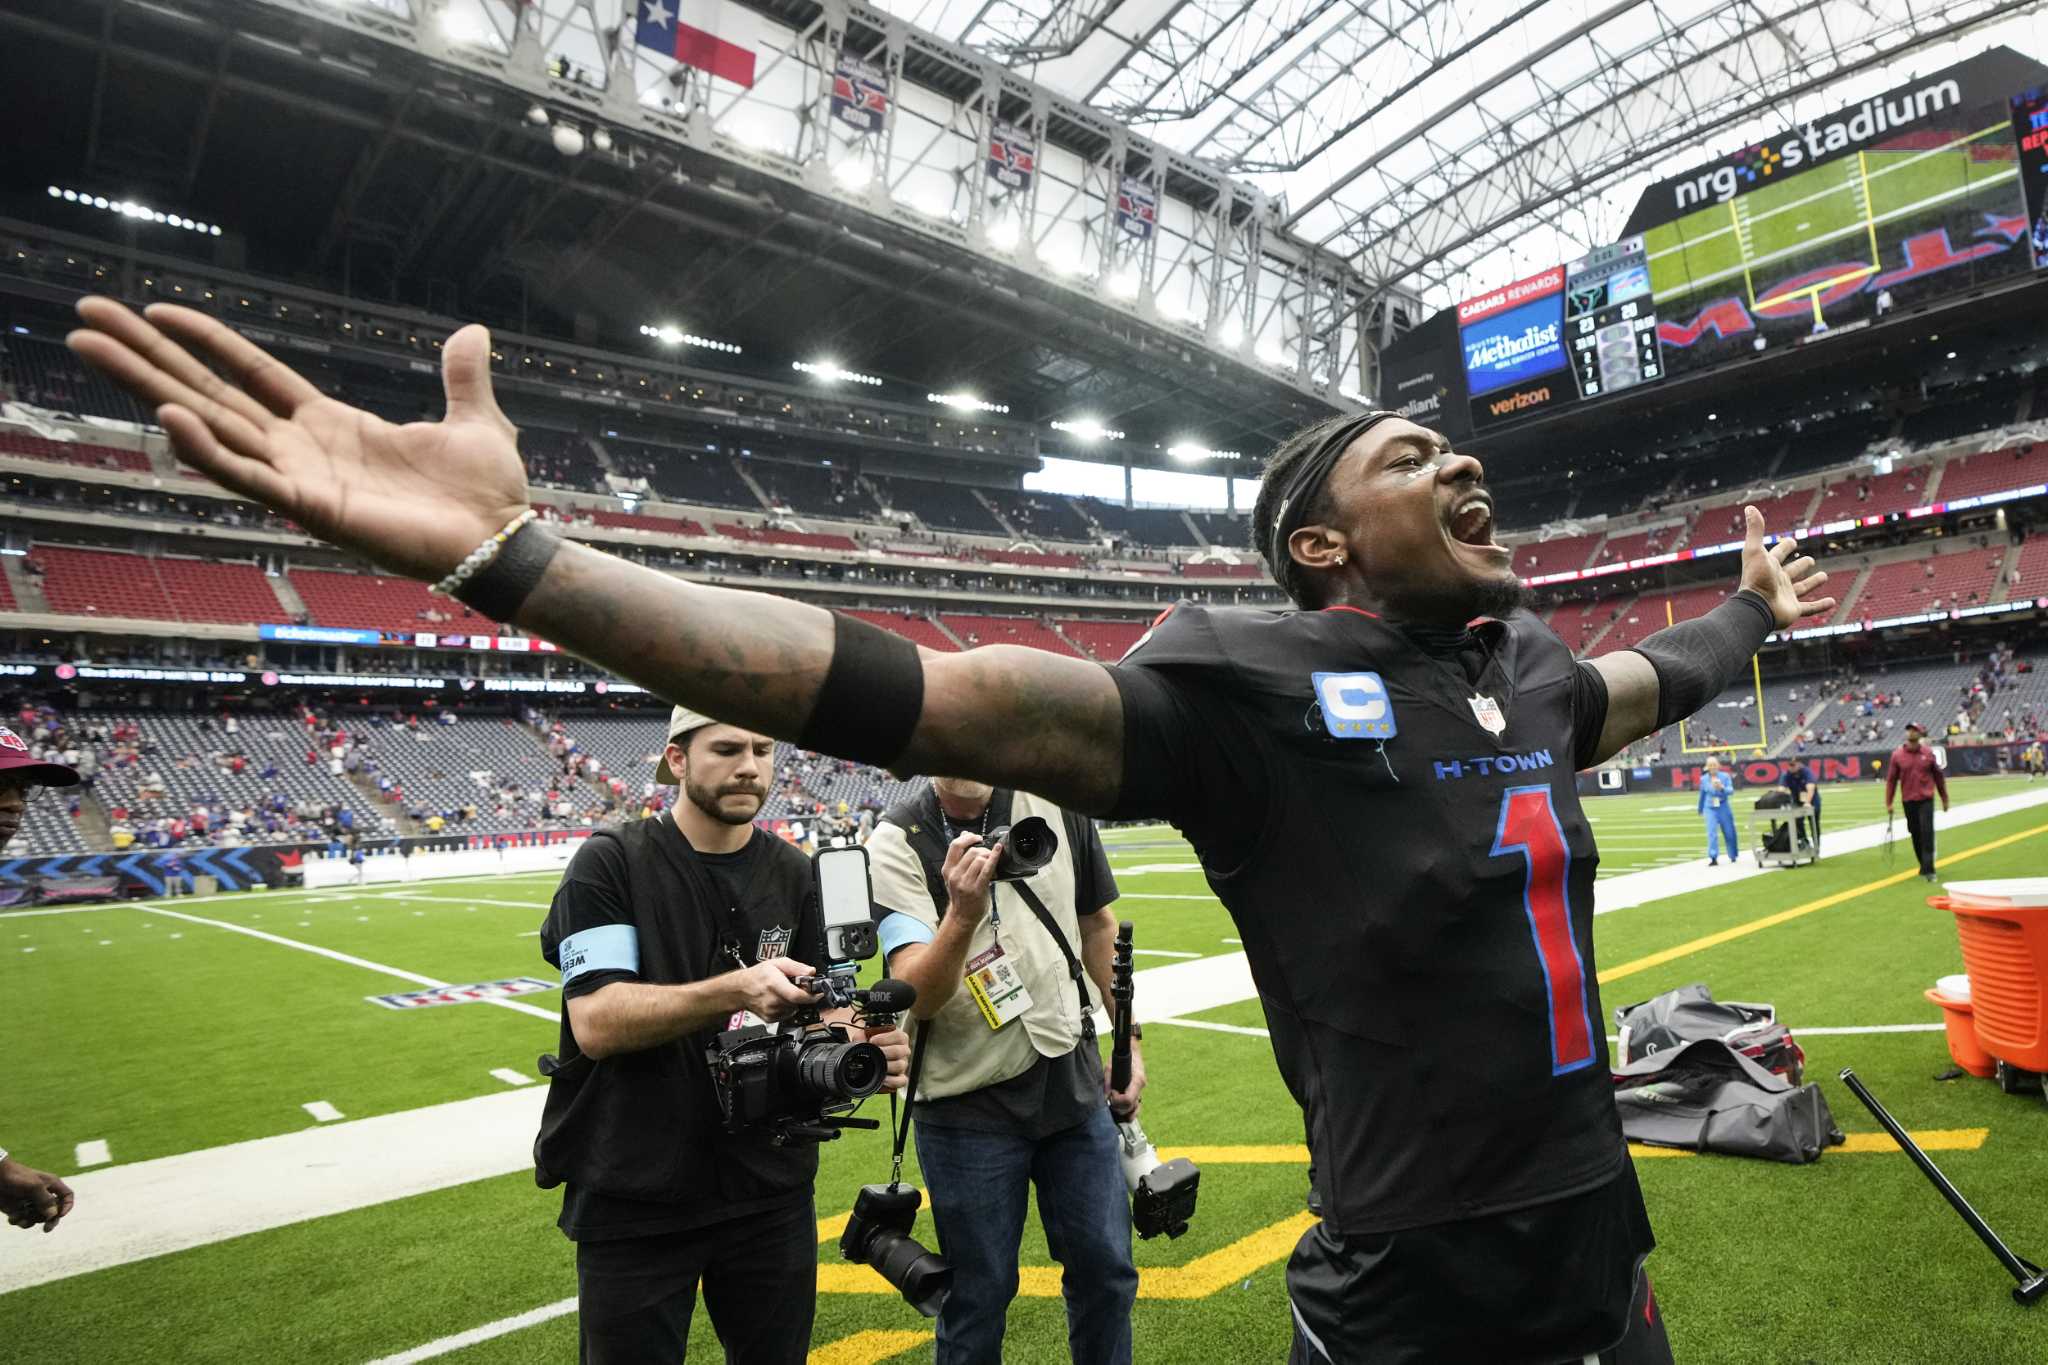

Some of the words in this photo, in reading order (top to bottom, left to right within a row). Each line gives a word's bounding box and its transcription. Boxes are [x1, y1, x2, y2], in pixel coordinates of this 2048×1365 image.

[1675, 165, 1737, 208] nrg
[1780, 79, 1961, 169] stadium
[1460, 293, 1506, 318] CAESARS
[1507, 273, 1561, 300] REWARDS
[1467, 322, 1560, 370] Methodist
[1490, 387, 1550, 415] verizon
[484, 679, 511, 691] FAN
[511, 680, 545, 692] FIRST
[546, 682, 586, 693] DEALS
[1320, 676, 1386, 720] C
[1433, 749, 1554, 780] H-TOWN
[761, 943, 783, 960] NFL
[1488, 783, 1597, 1077] 1
